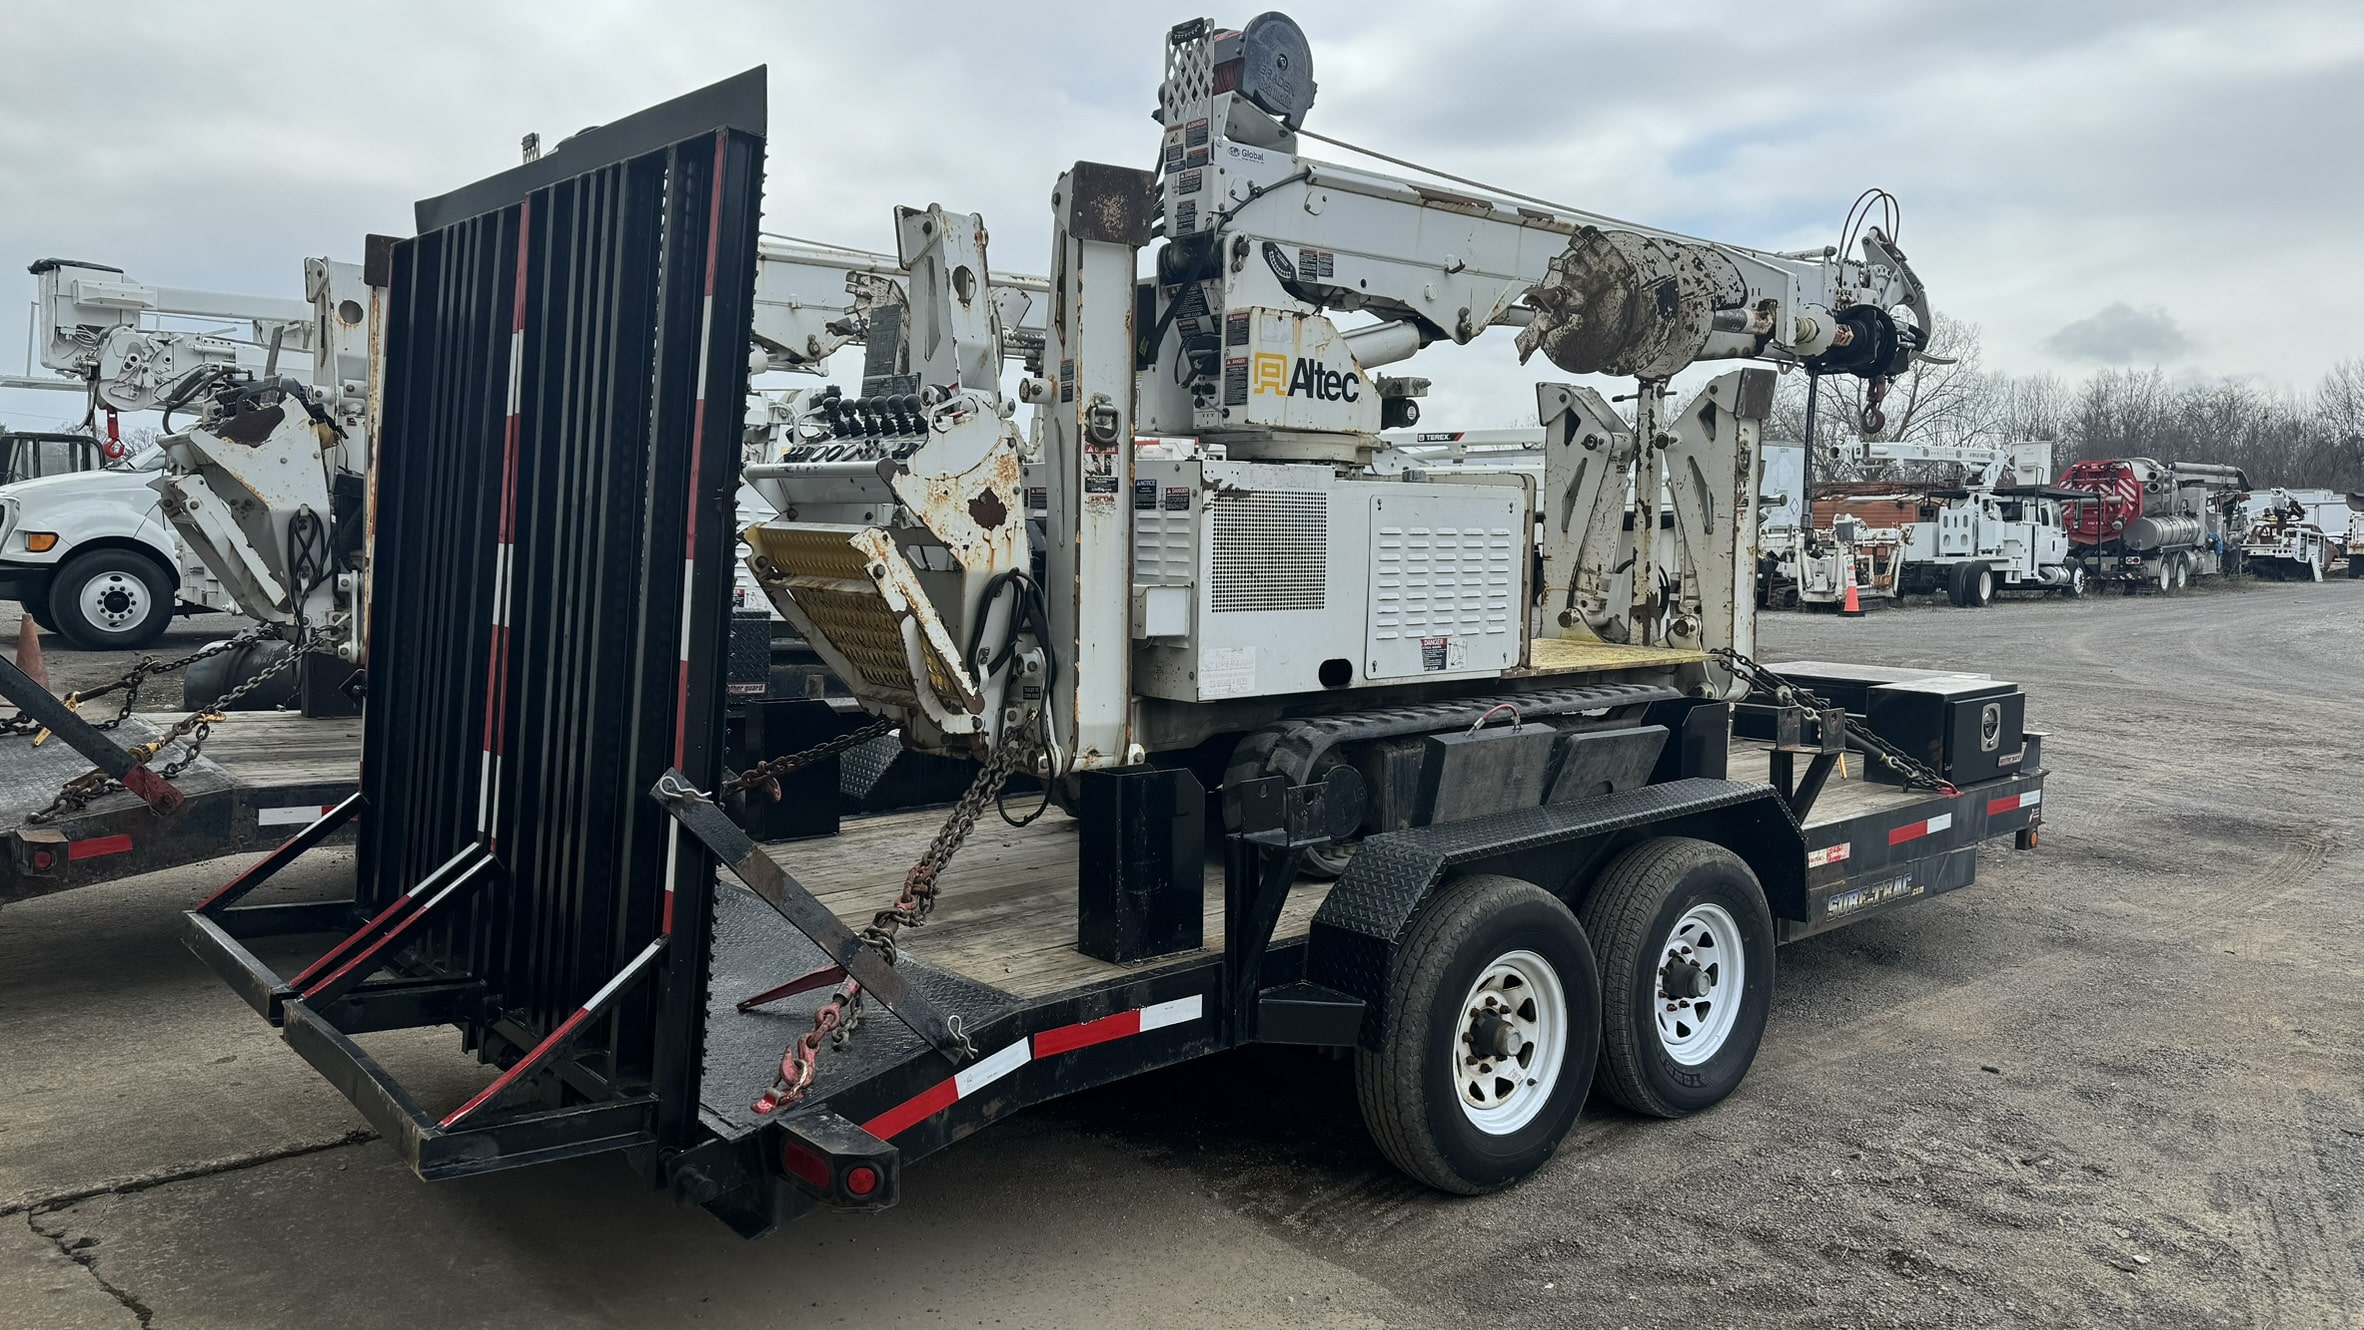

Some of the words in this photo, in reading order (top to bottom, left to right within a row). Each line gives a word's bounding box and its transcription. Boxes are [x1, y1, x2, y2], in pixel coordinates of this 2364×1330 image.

[1260, 63, 1296, 97] BRADEN
[1241, 149, 1264, 160] Global
[1287, 357, 1359, 402] Altec
